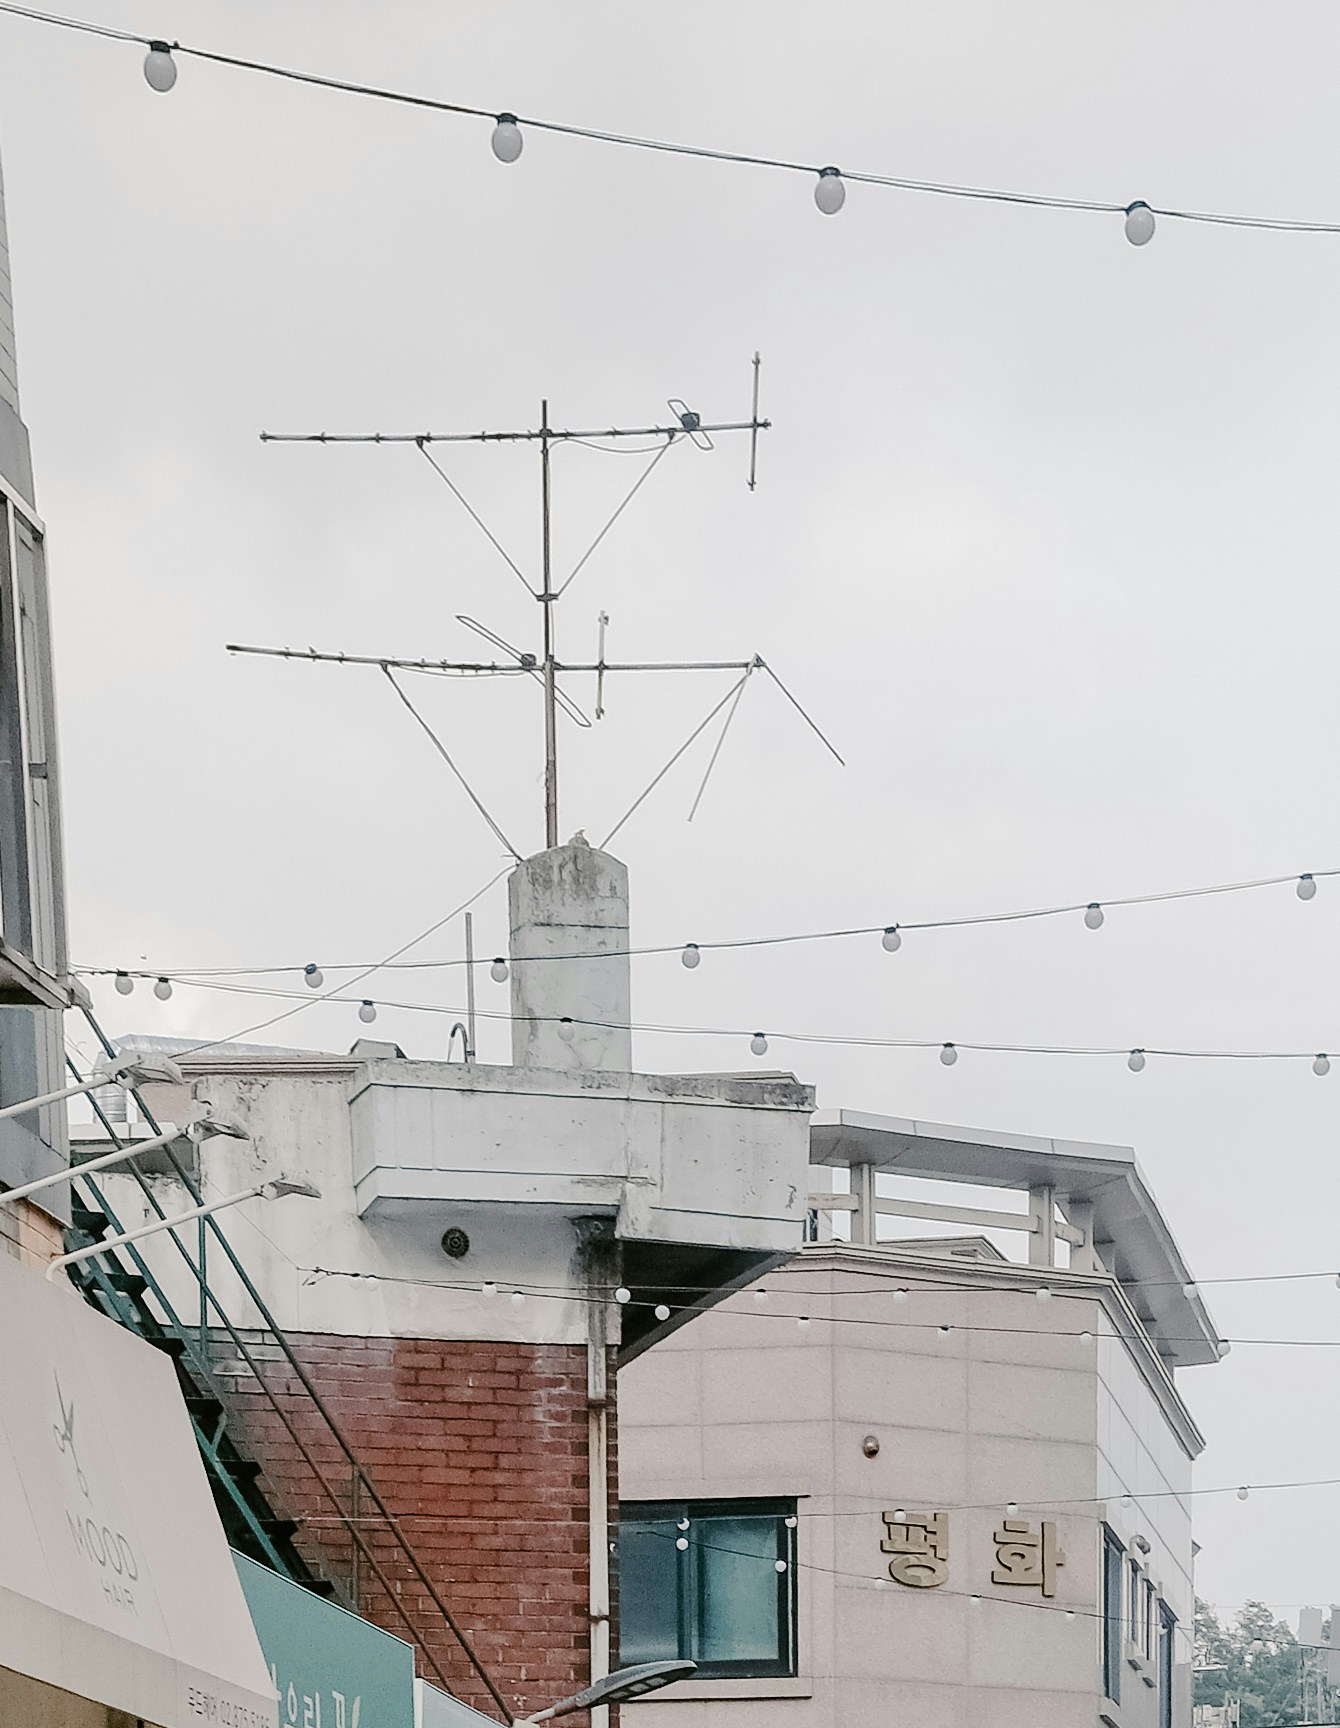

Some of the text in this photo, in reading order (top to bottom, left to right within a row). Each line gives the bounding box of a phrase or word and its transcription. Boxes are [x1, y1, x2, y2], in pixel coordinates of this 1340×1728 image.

[65, 1508, 140, 1582] MOOD
[880, 1510, 1065, 1597] 평화
[101, 1577, 142, 1618] HAIR
